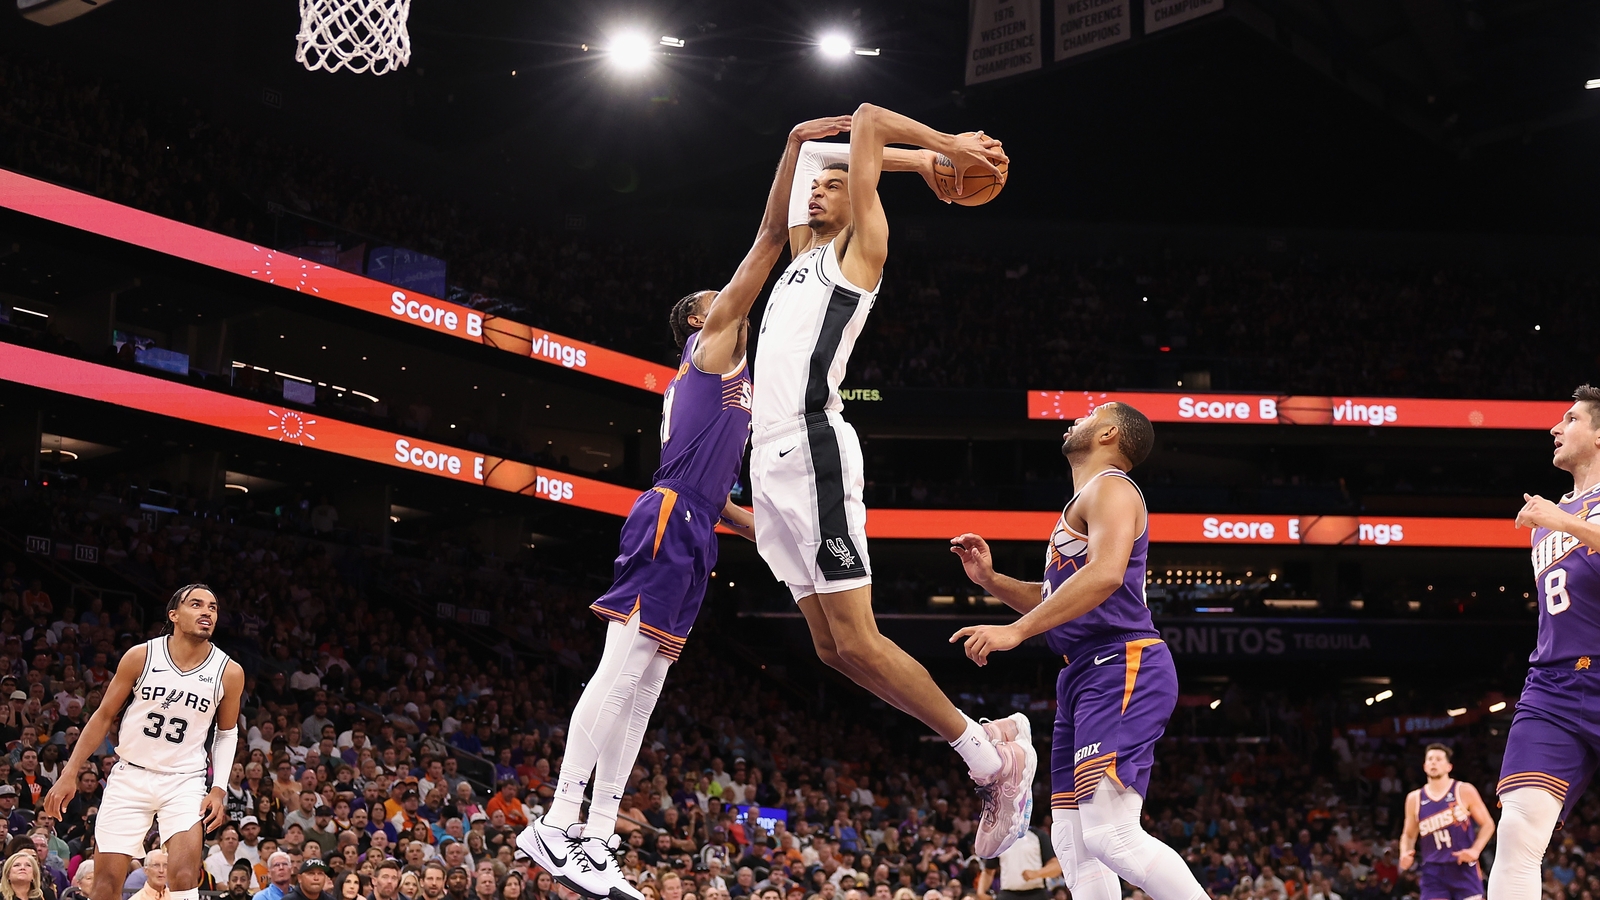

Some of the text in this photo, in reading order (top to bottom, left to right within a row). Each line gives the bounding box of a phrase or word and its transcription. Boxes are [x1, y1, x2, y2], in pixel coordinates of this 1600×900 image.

[994, 6, 1014, 22] 1976
[1060, 5, 1123, 36] CONFERENCE
[981, 20, 1026, 42] WESTERN
[1063, 23, 1121, 51] CHAMPIONS
[972, 33, 1035, 61] CONFERENCE
[975, 52, 1032, 76] CHAMPIONS
[390, 291, 458, 330] Score
[532, 334, 587, 368] vings
[838, 388, 883, 401] NUTES.
[1178, 397, 1250, 419] Score
[1333, 400, 1398, 425] vings
[394, 439, 461, 475] Score
[536, 475, 574, 501] ngs
[1203, 517, 1275, 539] Score
[1359, 523, 1404, 545] ngs
[32, 539, 46, 552] 114
[80, 547, 94, 560] 115
[1544, 568, 1571, 616] 8
[1162, 626, 1371, 655] RNITOS TEQUILA
[198, 674, 214, 684] Self.
[141, 687, 211, 713] SPURS
[143, 712, 188, 744] 33
[1074, 742, 1101, 765] ENIX
[1419, 809, 1454, 837] SUNS
[1433, 829, 1452, 850] 14
